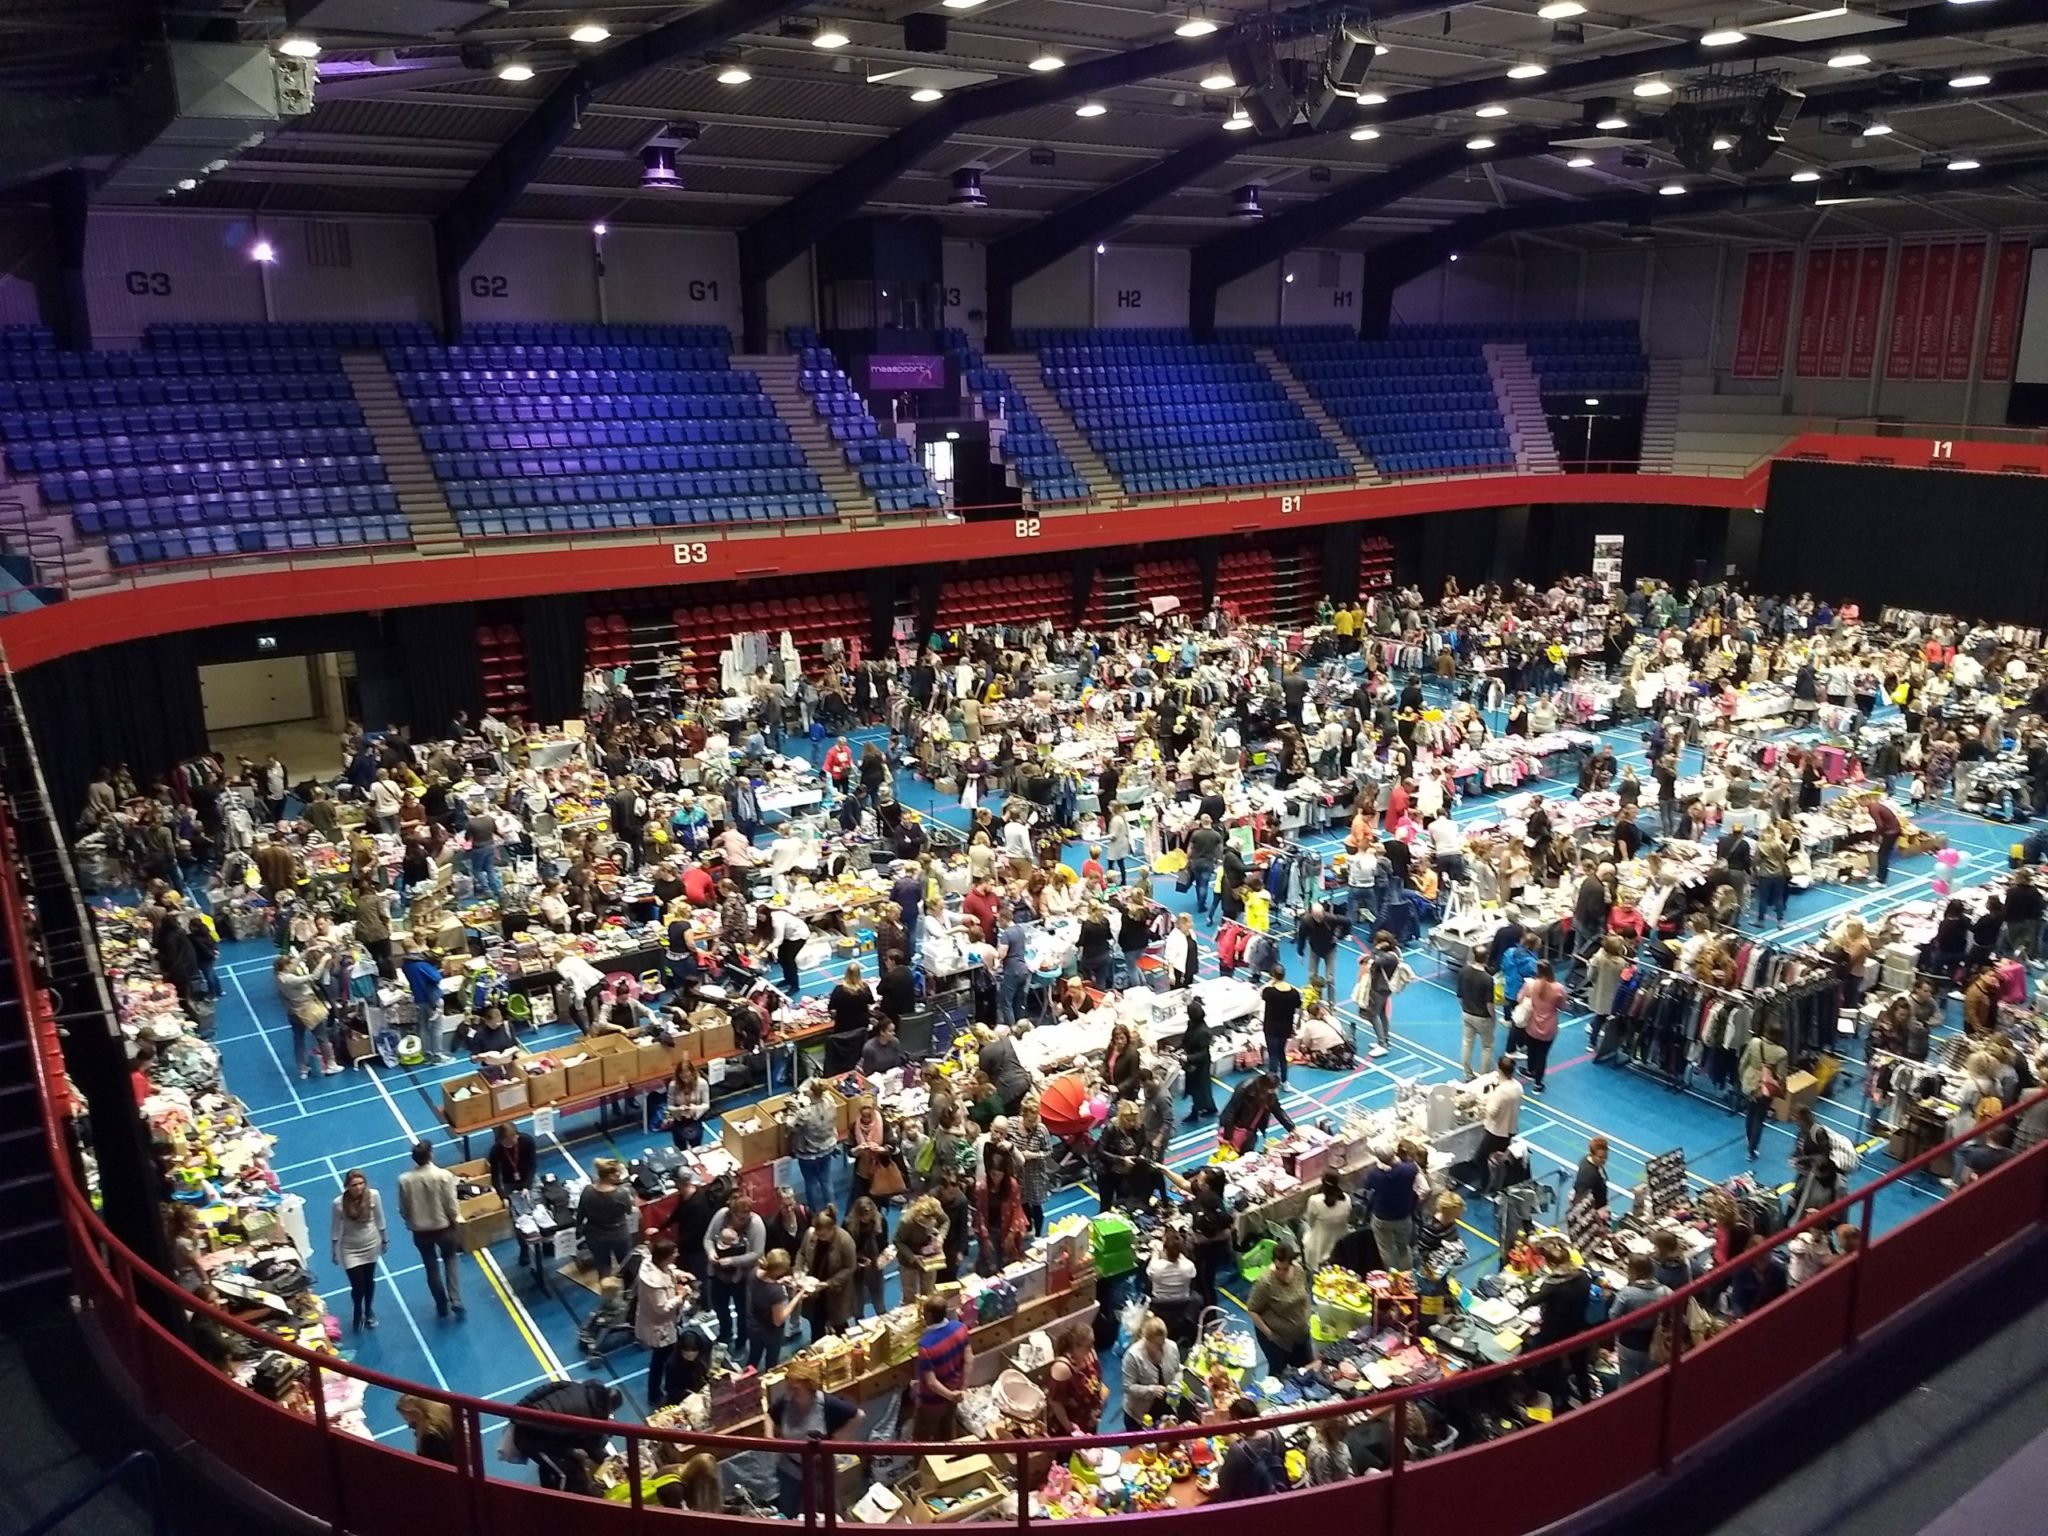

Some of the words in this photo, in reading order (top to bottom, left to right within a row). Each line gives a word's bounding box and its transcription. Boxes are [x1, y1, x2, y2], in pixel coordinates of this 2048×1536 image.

[125, 271, 172, 296] G3
[470, 275, 508, 298] G2
[689, 280, 718, 301] G1
[1118, 290, 1141, 308] H2
[1333, 291, 1352, 307] H1
[1892, 314, 1904, 353] NASHUA
[1921, 314, 1933, 353] NASHUA
[1950, 314, 1962, 353] NASHUA
[1990, 314, 2002, 354] NASHUA
[1281, 495, 1301, 513] B1
[1015, 518, 1040, 538] B2
[673, 542, 708, 565] B3
